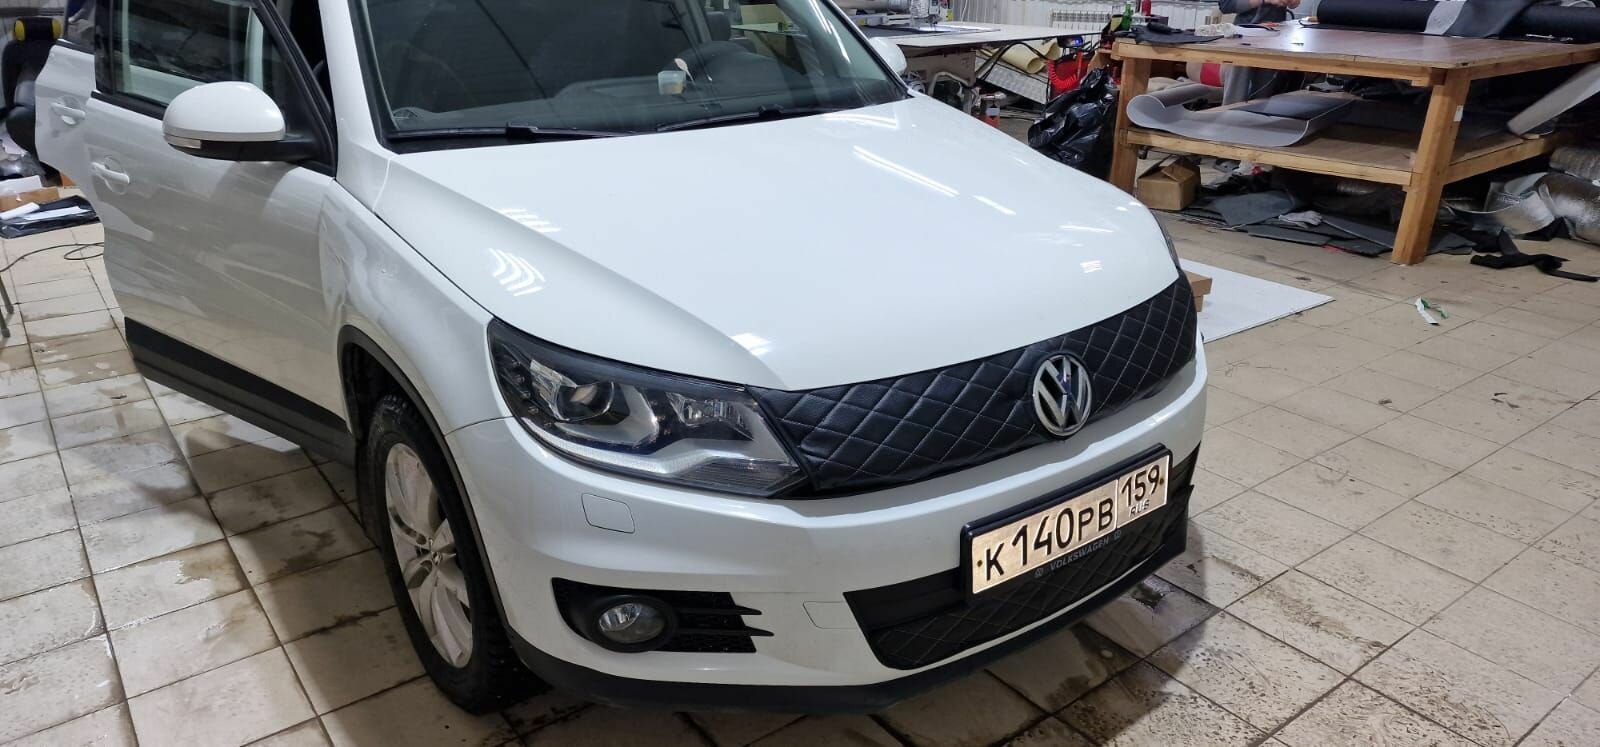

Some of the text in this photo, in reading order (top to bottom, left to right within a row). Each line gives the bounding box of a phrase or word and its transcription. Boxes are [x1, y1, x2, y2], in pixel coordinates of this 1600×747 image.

[1121, 464, 1160, 507] 159
[1130, 499, 1150, 516] RUS
[1049, 536, 1109, 571] VOLKSWAGEN
